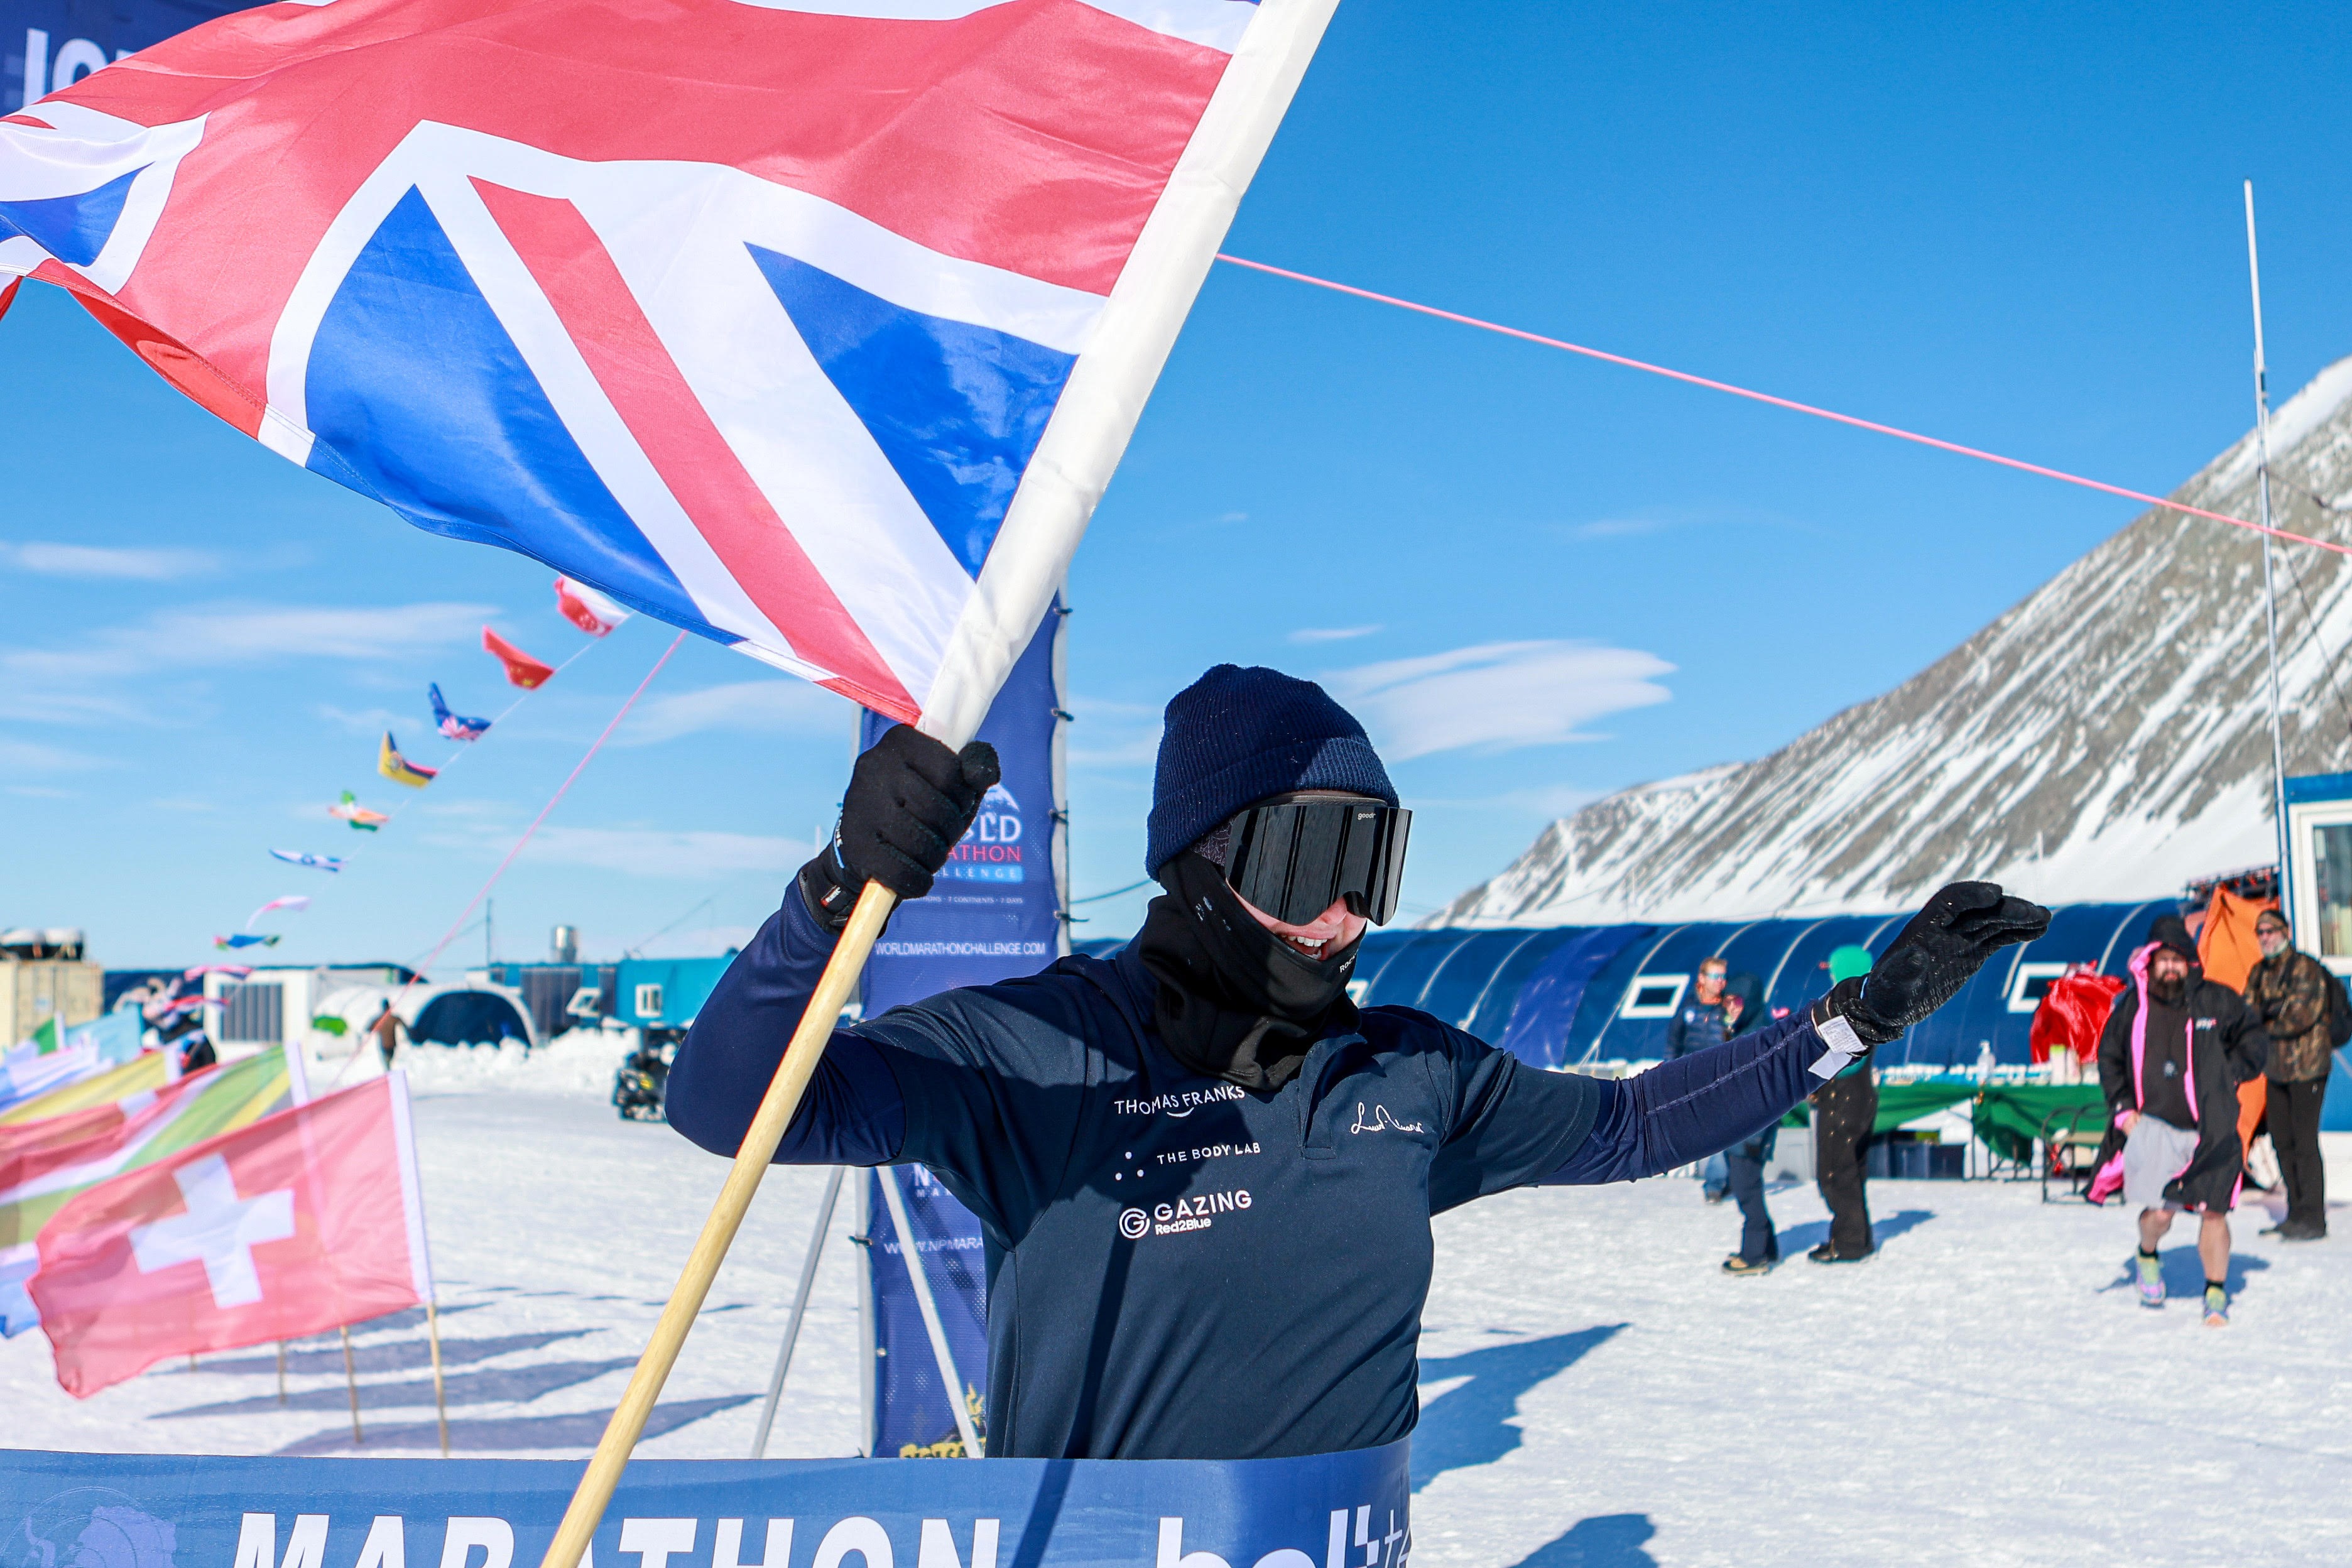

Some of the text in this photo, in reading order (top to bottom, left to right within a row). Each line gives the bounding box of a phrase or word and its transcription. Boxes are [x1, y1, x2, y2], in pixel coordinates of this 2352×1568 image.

[1357, 812, 1376, 820] goodr
[876, 943, 1046, 955] WORLDMARATHONCHALLENGE.COM
[1114, 1086, 1245, 1114] THOMAS FRANKS
[1157, 1143, 1261, 1165] THE BODY LAB
[1154, 1190, 1253, 1221] GAZING
[1155, 1217, 1212, 1236] Red2Blue
